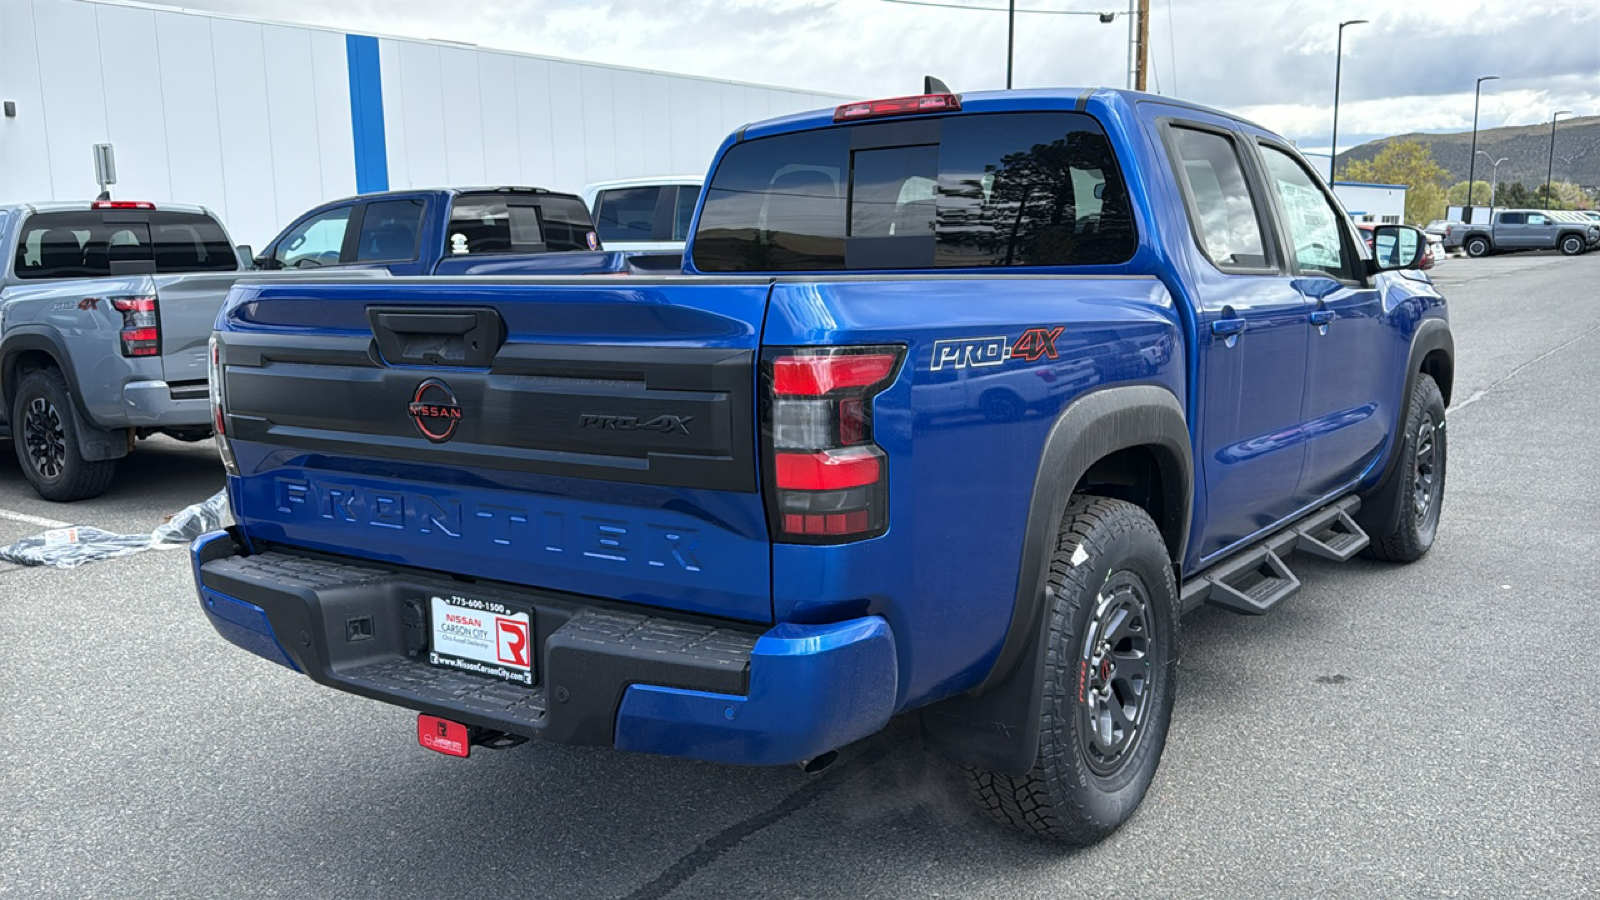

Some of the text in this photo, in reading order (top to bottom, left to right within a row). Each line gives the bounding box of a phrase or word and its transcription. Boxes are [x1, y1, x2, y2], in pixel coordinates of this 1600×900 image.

[930, 326, 1065, 371] PRO-4X
[409, 404, 462, 419] NISSAN
[578, 413, 694, 436] PRO-4X
[274, 476, 702, 572] FRONTIER
[451, 596, 504, 613] 775-600-1500
[446, 614, 481, 627] NISSAN
[441, 623, 488, 640] CARSON CITY
[439, 658, 524, 680] www.NissanCarsonCity.com
